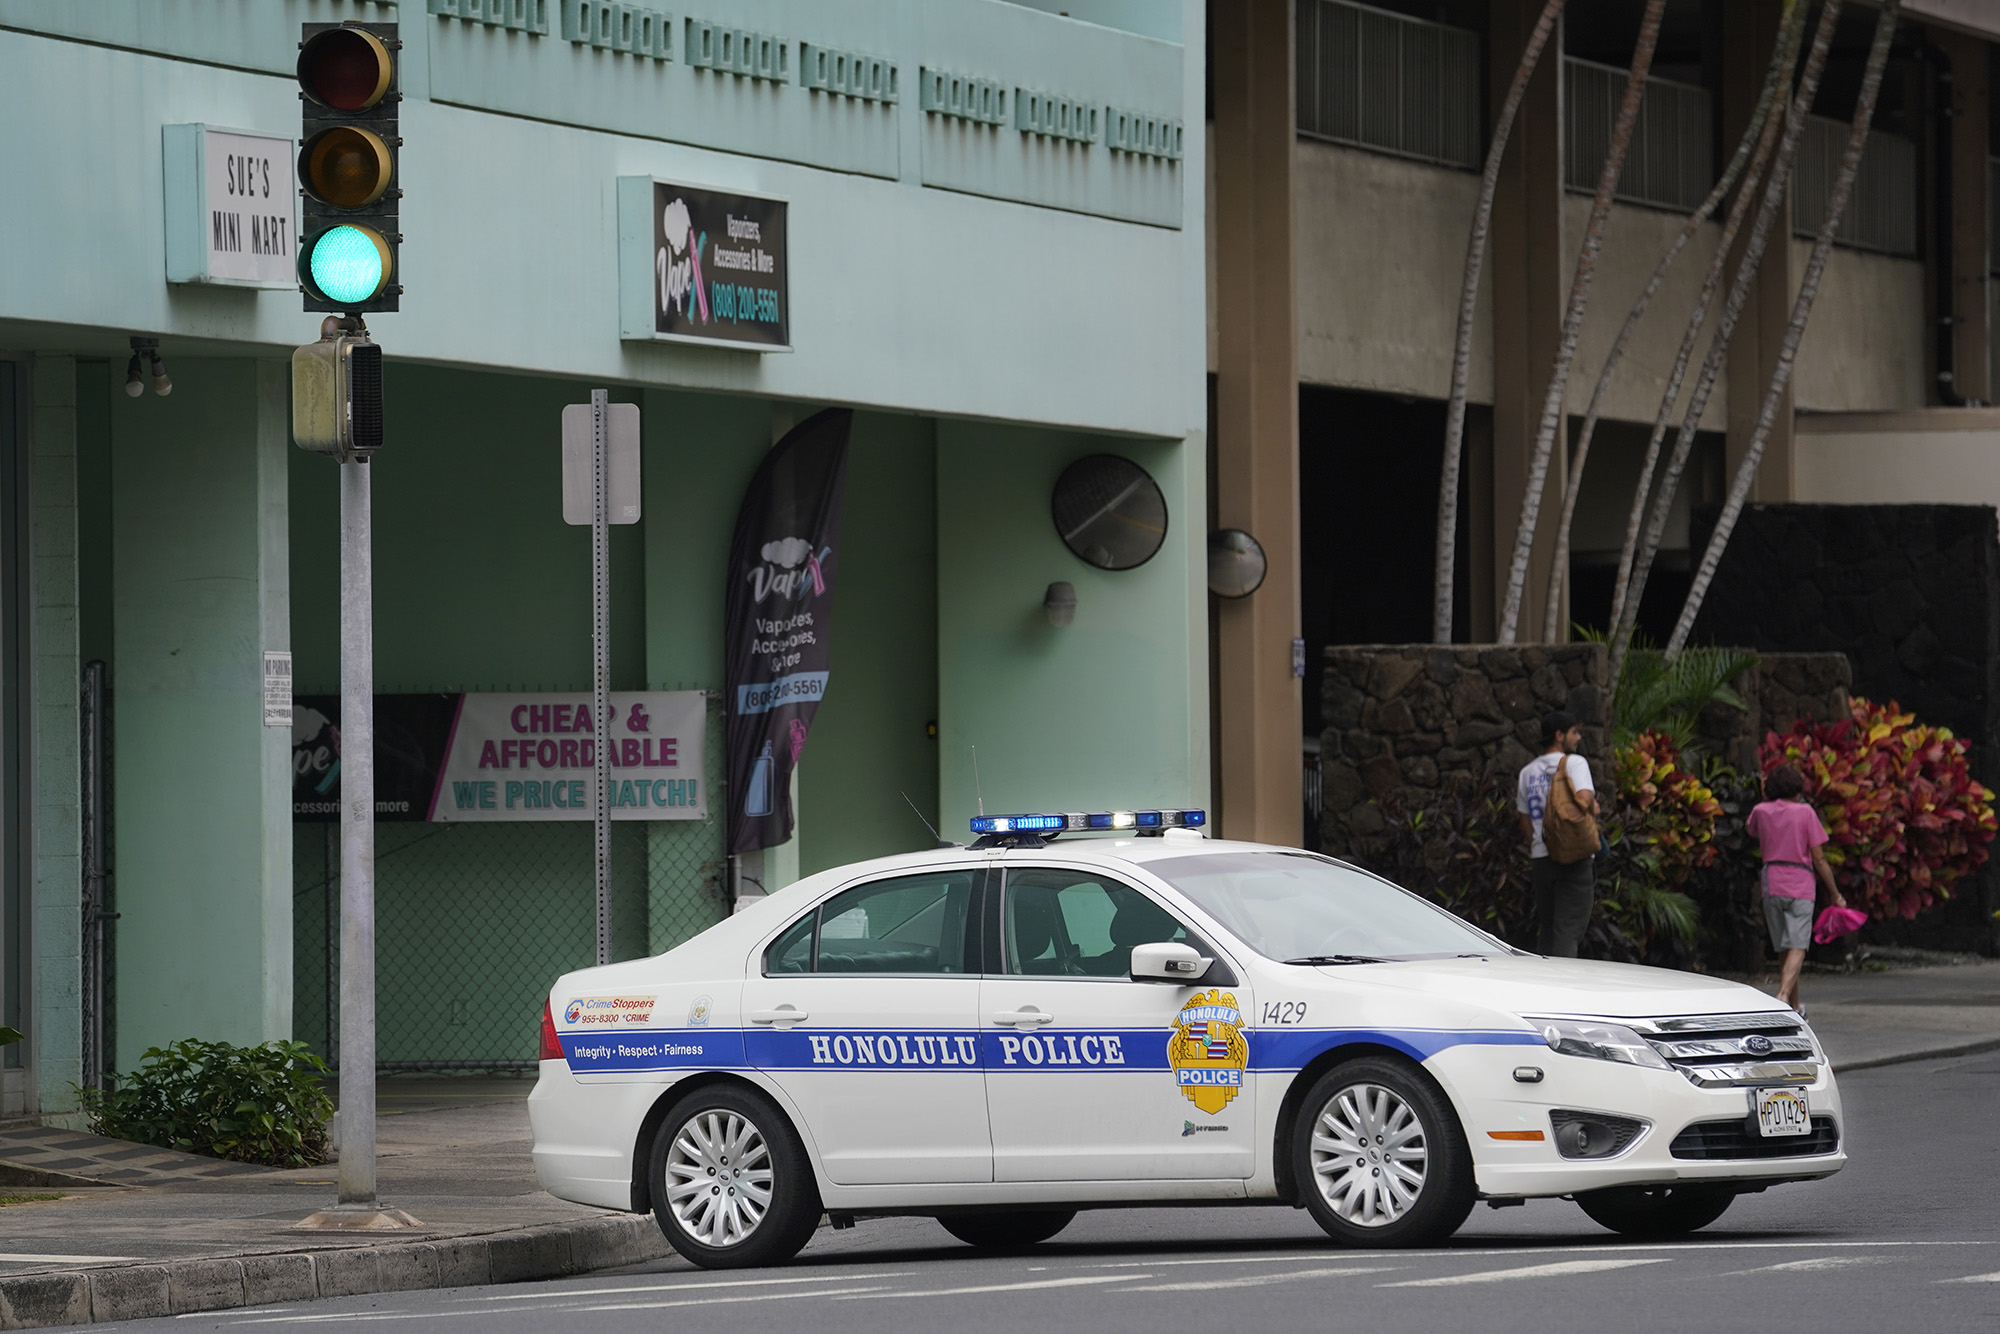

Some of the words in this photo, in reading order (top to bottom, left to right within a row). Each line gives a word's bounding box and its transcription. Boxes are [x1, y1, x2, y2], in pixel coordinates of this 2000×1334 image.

[227, 153, 270, 199] SUE'S
[213, 210, 242, 252] MINI
[252, 214, 286, 256] MART
[727, 213, 761, 243] Vaporizers,
[714, 244, 750, 271] Accessories
[751, 248, 757, 271] &
[757, 249, 774, 273] More
[657, 244, 692, 316] Vape
[712, 280, 737, 325] (808)
[738, 286, 779, 323] 200-5561
[747, 564, 807, 603] Vap
[272, 660, 291, 676] PARKING
[627, 703, 649, 733] &
[376, 801, 410, 813] more
[453, 781, 497, 809] WE
[505, 780, 585, 808] PRICE
[611, 779, 697, 807] ATCH!
[586, 998, 655, 1010] CrimeStoppers
[1182, 1005, 1238, 1023] HONOLULU
[1262, 1001, 1307, 1024] 1429
[581, 1014, 619, 1024] 955-8300
[574, 1045, 611, 1059] Integrity
[618, 1045, 657, 1059] Respect
[664, 1043, 703, 1056] Fairness
[808, 1035, 977, 1065] HONOLULU
[999, 1035, 1125, 1065] POLICE
[1180, 1070, 1239, 1084] POLICE
